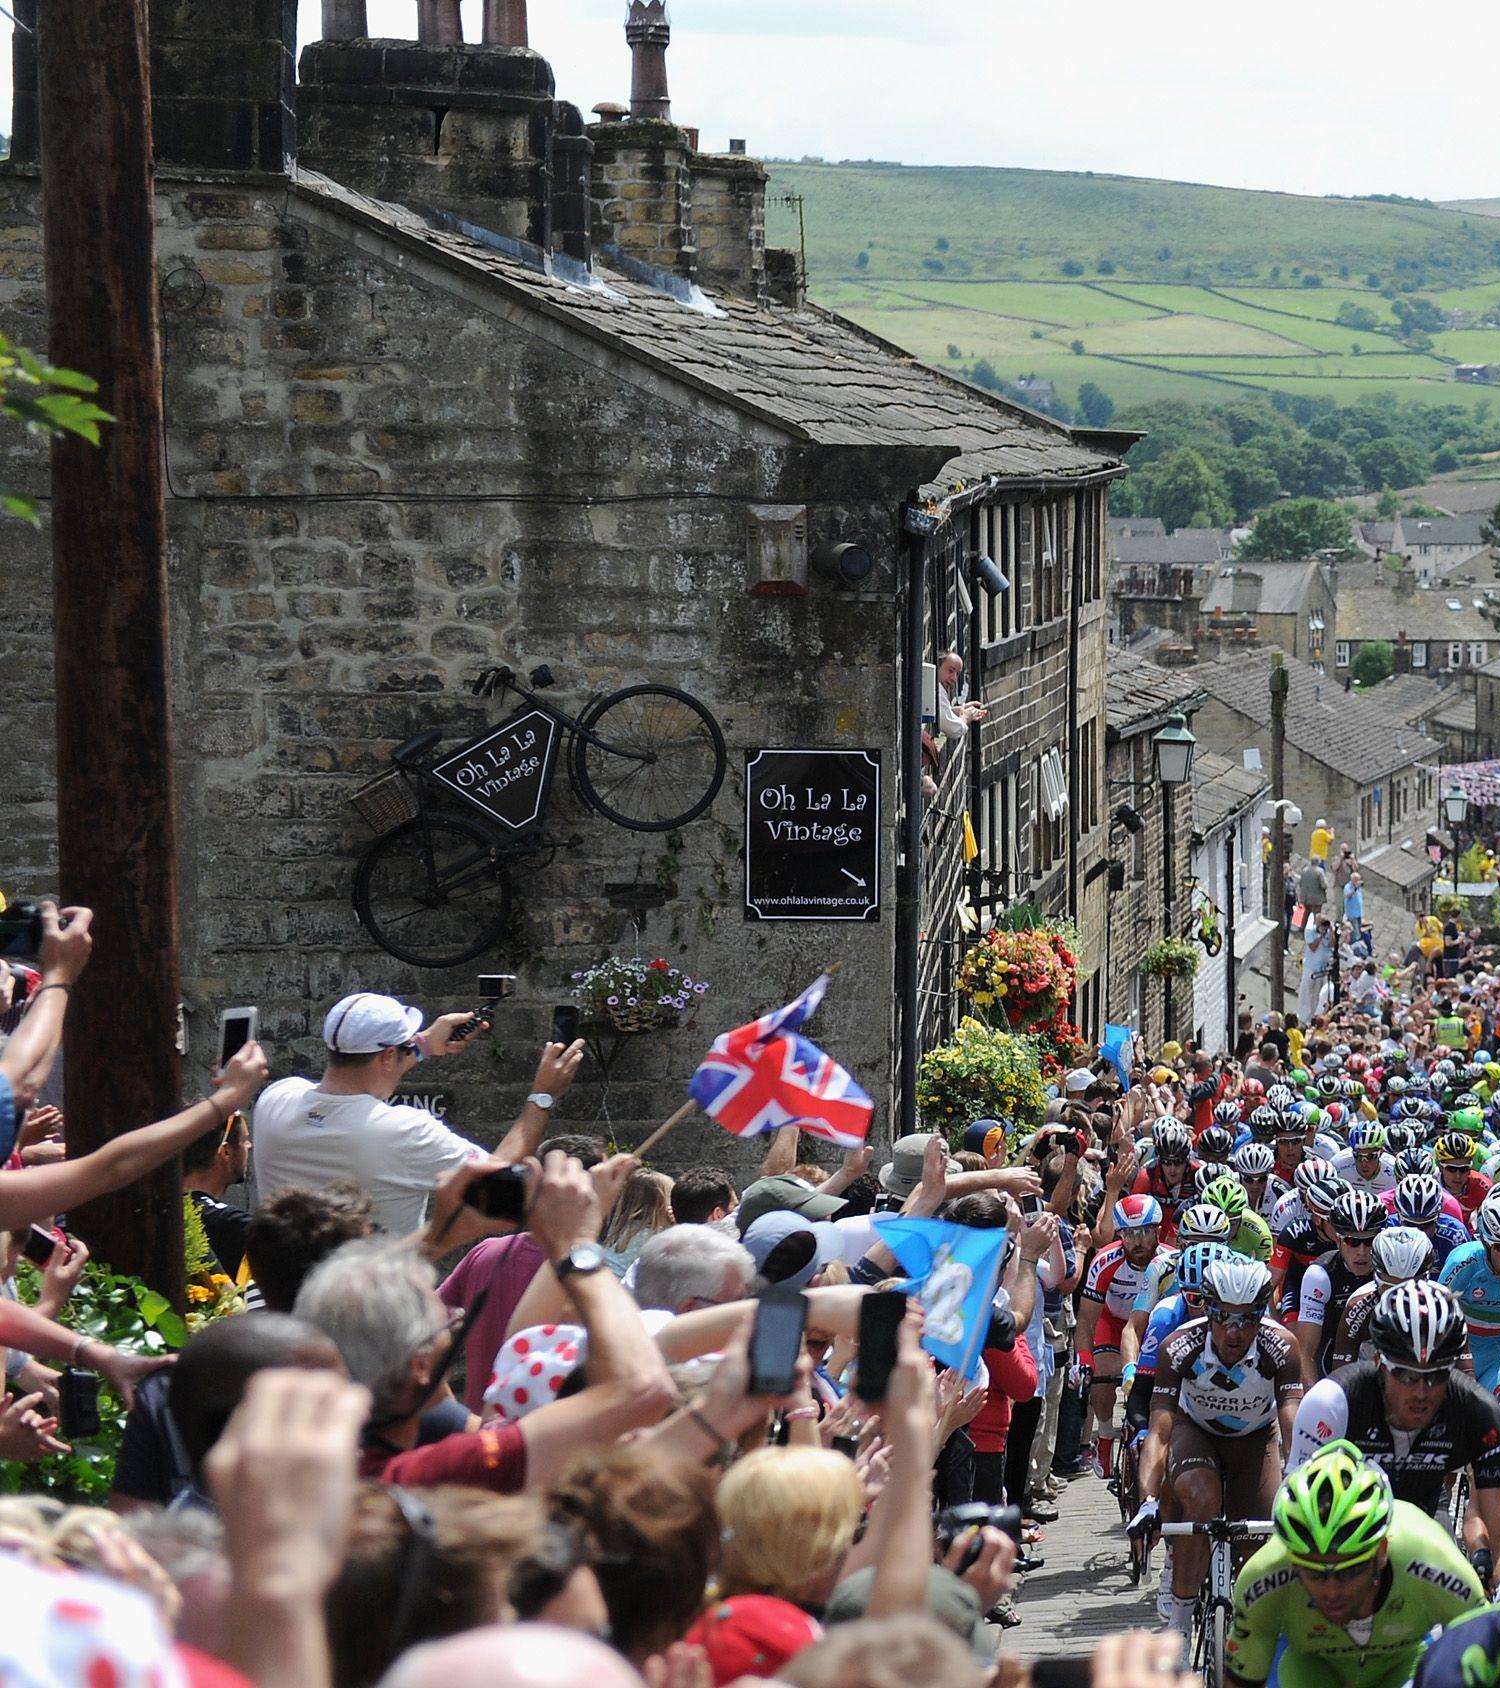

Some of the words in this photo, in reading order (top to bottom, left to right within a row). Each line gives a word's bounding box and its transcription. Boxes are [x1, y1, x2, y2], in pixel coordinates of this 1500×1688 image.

[457, 760, 488, 786] Oh
[485, 746, 511, 767] La
[511, 730, 536, 751] La
[475, 756, 540, 797] Vintage
[760, 784, 796, 811] Oh
[805, 787, 831, 810] La
[841, 788, 867, 811] La
[764, 820, 862, 846] Vintage
[754, 896, 870, 907] www.ohlalavintage.co.uk
[1243, 1221, 1263, 1236] KENDA
[1287, 1219, 1312, 1239] IAM
[1445, 1256, 1478, 1286] STANA
[1345, 1301, 1365, 1325] AG2R
[1166, 1332, 1192, 1357] AG2R
[1190, 1327, 1204, 1339] LA
[1259, 1325, 1278, 1345] AG2R
[1277, 1336, 1292, 1356] LA
[1364, 1452, 1449, 1464] TREK
[1244, 1568, 1299, 1604] KENDA
[1407, 1559, 1472, 1600] KENDA
